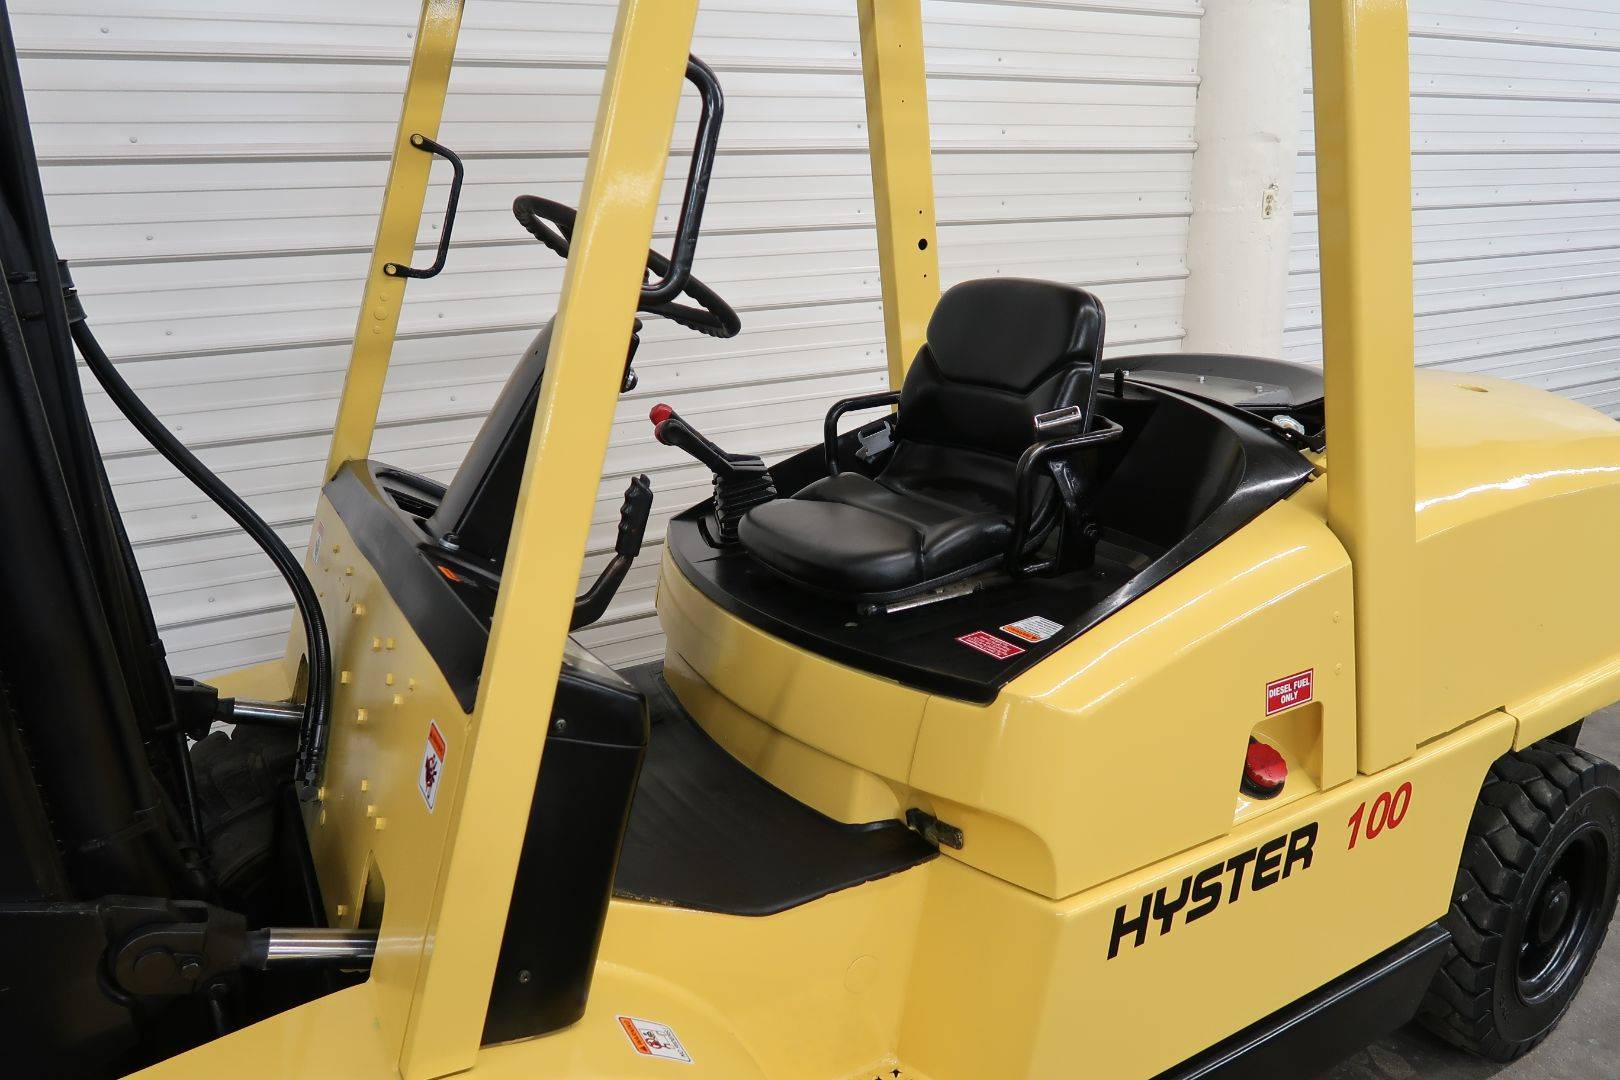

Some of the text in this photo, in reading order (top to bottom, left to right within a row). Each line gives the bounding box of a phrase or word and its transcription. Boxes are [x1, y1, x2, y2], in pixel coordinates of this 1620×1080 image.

[1269, 678, 1309, 698] DIESEL FUEL
[1281, 691, 1298, 704] ONLY
[1107, 781, 1413, 961] HYSTER 100
